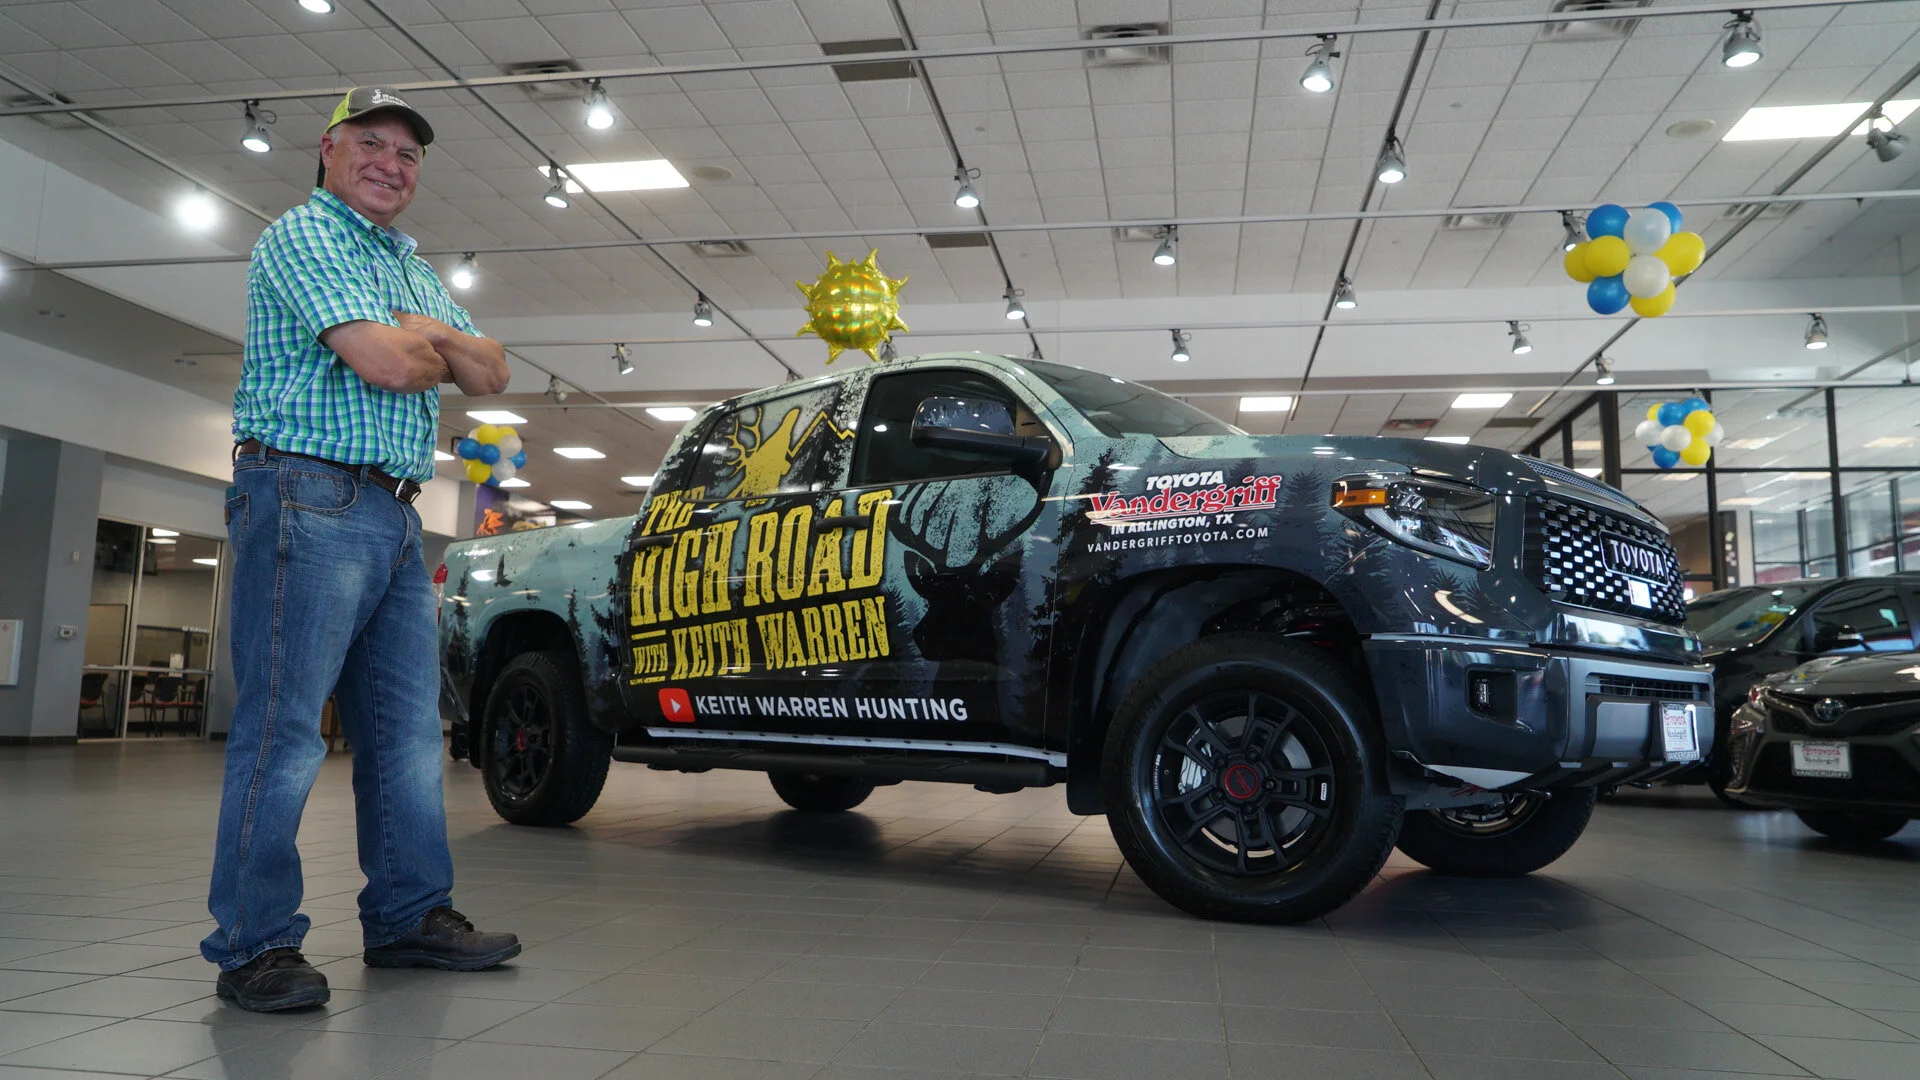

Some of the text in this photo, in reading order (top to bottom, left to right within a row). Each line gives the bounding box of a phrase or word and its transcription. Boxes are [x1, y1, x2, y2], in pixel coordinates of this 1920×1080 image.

[1088, 475, 1283, 519] Vandergriff
[1146, 470, 1224, 491] TOYOTA
[641, 486, 705, 537] THE
[1111, 512, 1235, 536] IN ARLINGTON, TX
[630, 488, 895, 627] HIGH ROAD
[1087, 527, 1269, 553] VANDERGRIFFTOYOTA.COM
[1608, 538, 1665, 578] TOYOTA
[632, 596, 890, 681] WITH KEITH WARREN
[695, 695, 969, 722] KEITH WARREN HUNTING
